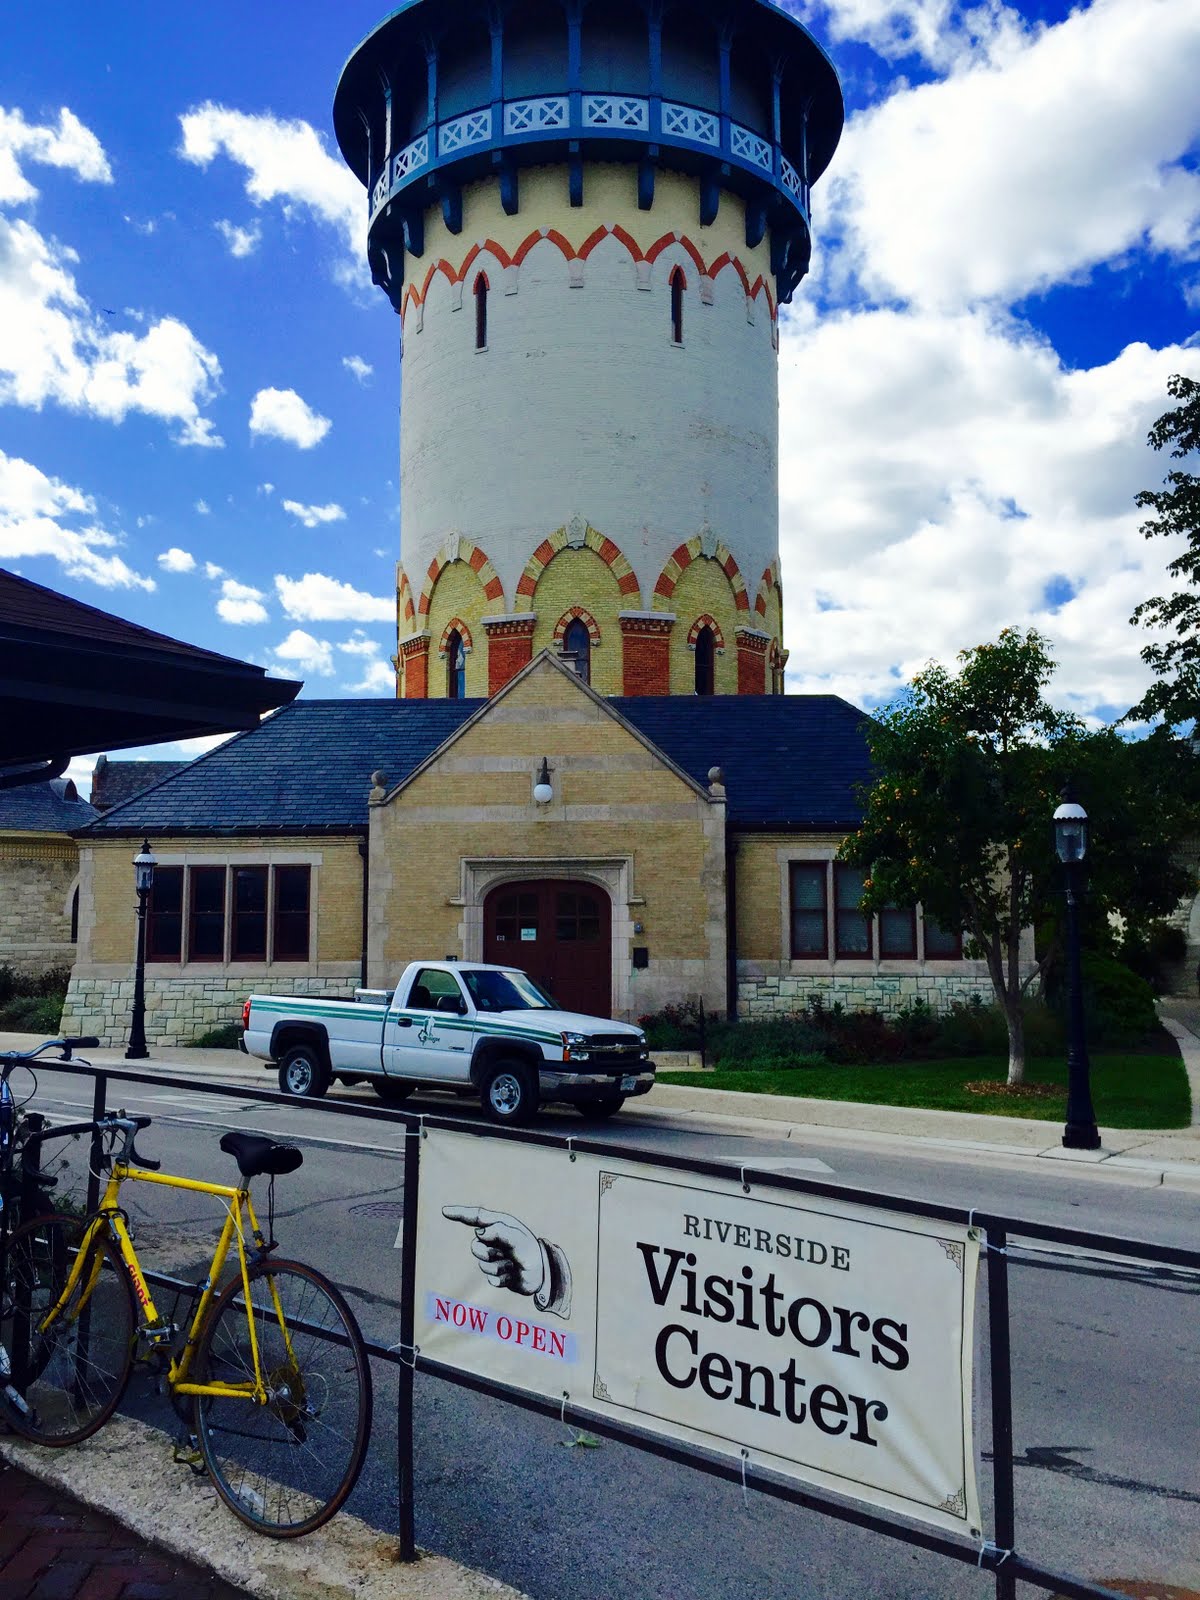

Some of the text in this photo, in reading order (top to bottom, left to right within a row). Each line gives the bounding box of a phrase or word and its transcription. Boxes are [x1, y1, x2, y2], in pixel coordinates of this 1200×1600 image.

[683, 1213, 850, 1272] RIVERSIDE
[434, 1298, 567, 1358] NOW OPEN
[636, 1241, 910, 1372] Visitors
[654, 1323, 889, 1448] Center
